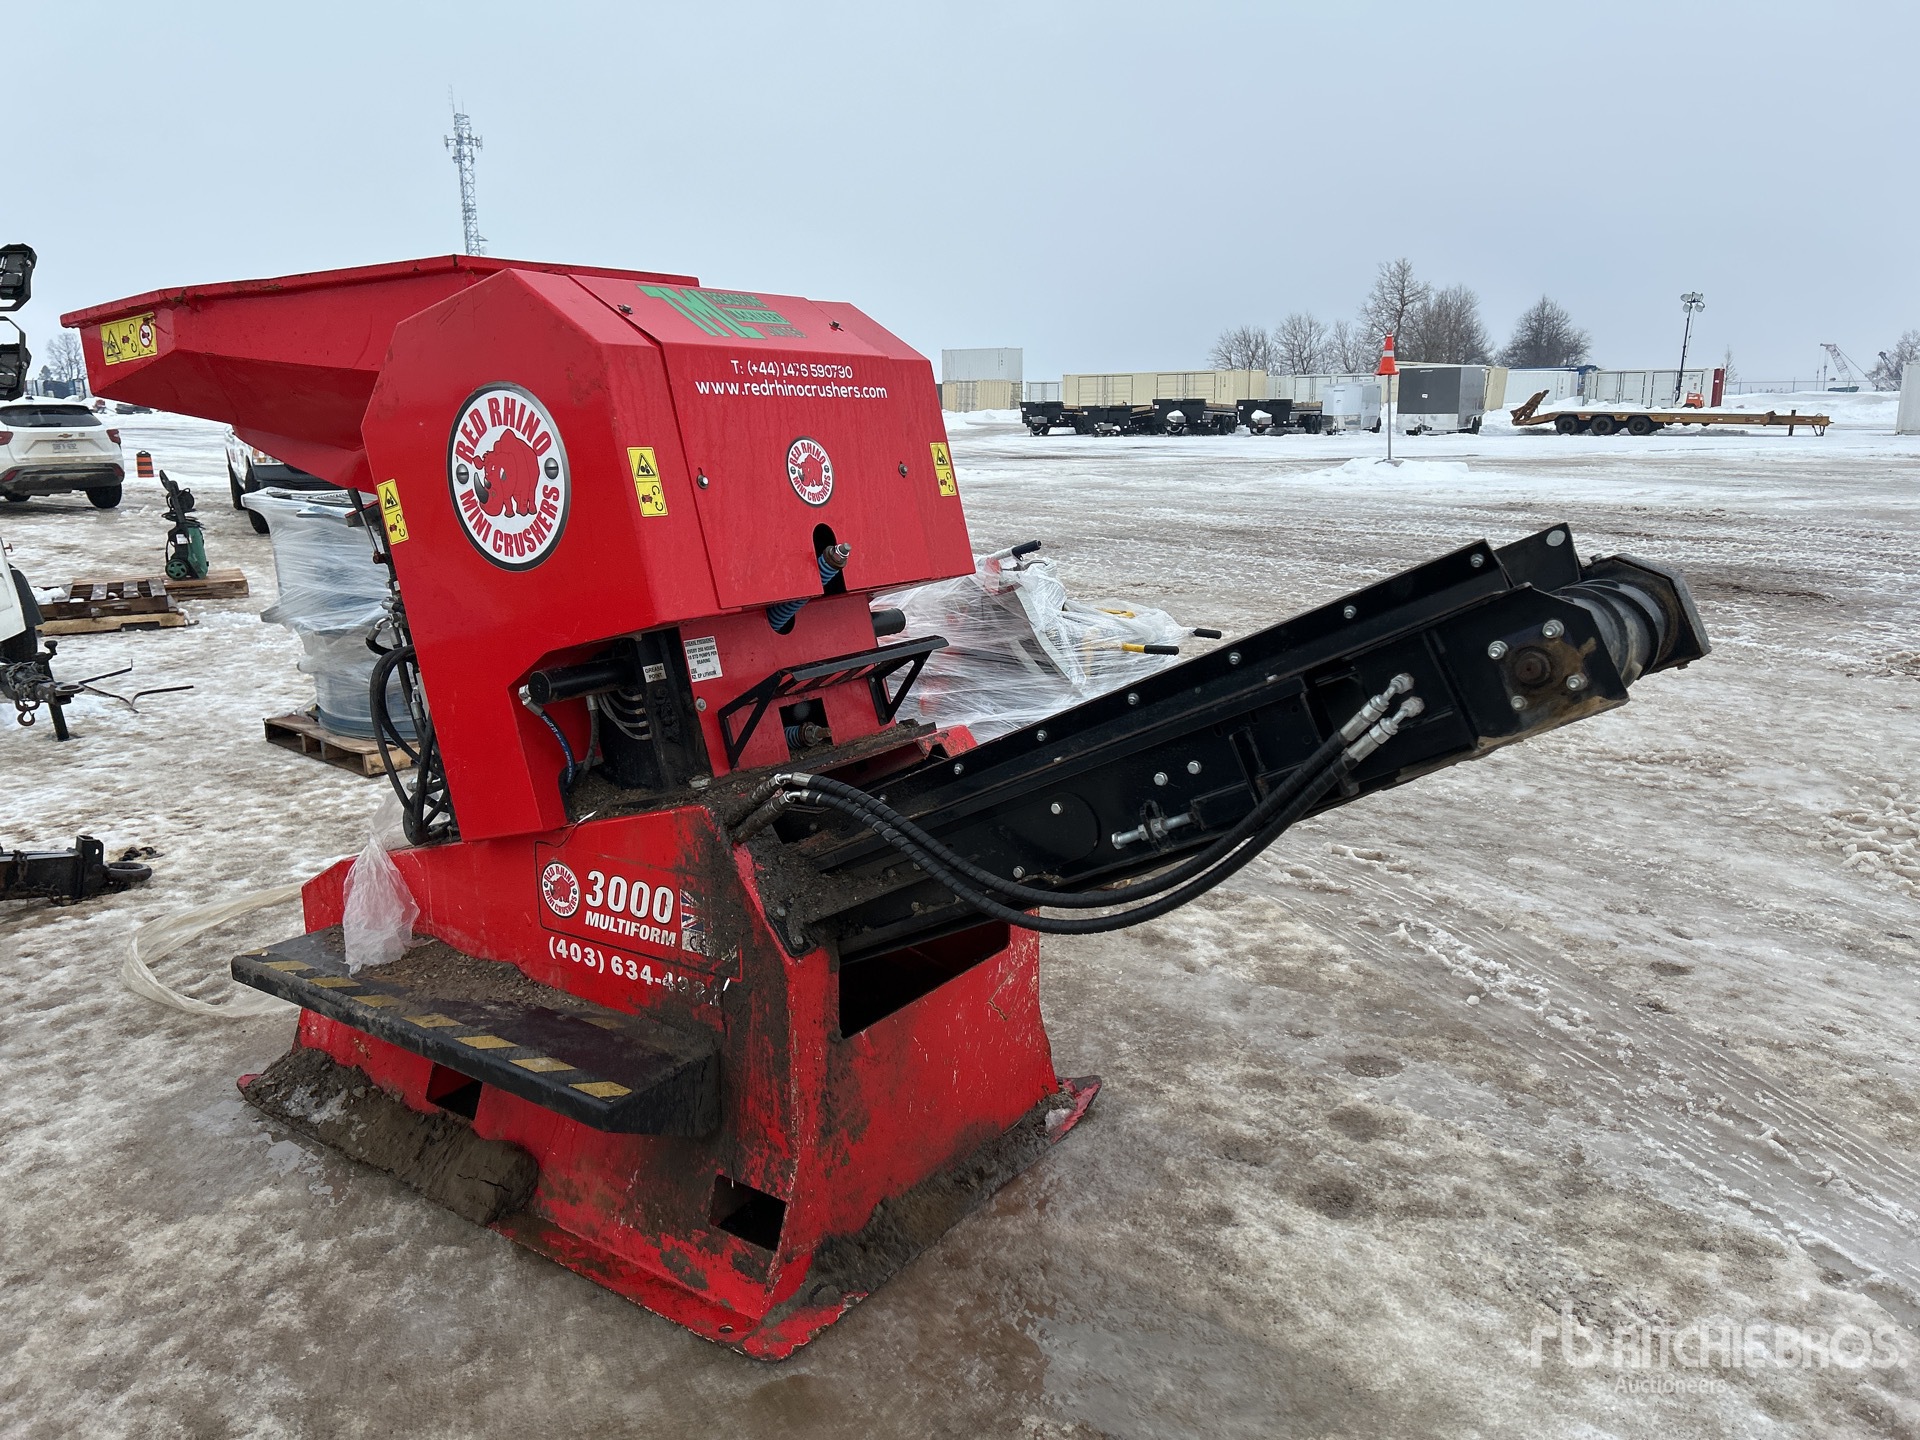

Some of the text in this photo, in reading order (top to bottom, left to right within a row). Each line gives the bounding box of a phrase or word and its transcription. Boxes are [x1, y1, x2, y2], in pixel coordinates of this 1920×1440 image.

[747, 360, 780, 377] (+44)
[810, 364, 853, 379] 590790
[695, 379, 888, 399] www.redrhinocrushers.com
[456, 397, 552, 465] RED RHINO
[789, 442, 826, 467] RED RHINO
[793, 475, 831, 502] MINI CRUSHERS
[459, 484, 560, 557] MINI CRUSHERS
[544, 865, 575, 887] RED RHINO
[545, 890, 577, 914] MINI CRUSHERS
[585, 870, 674, 924] 3000
[585, 910, 676, 947] MULTIFORM
[549, 936, 605, 974] (403)
